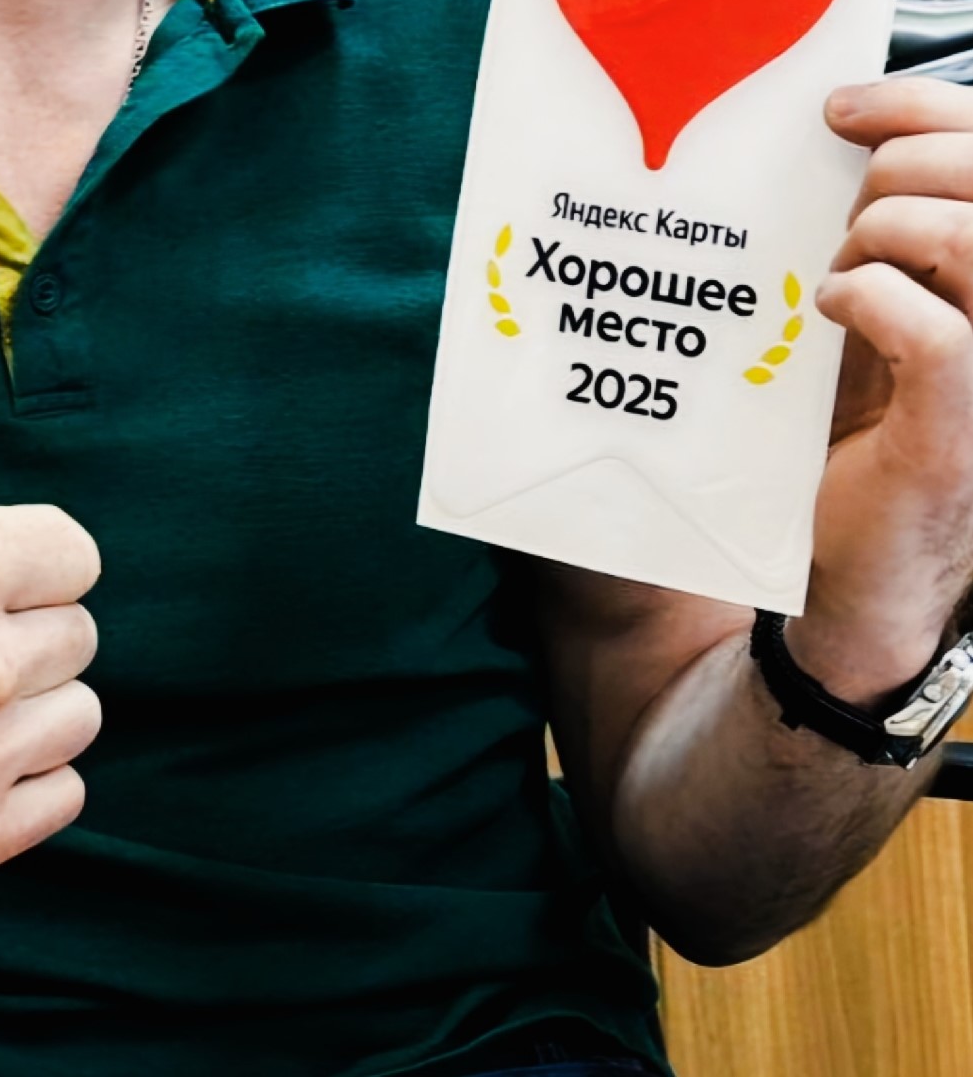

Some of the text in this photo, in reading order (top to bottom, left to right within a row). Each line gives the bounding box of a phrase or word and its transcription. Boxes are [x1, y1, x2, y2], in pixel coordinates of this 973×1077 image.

[551, 192, 748, 250] Яндекс Карты
[525, 237, 758, 317] Хорошее
[558, 302, 707, 358] место
[565, 362, 679, 421] 2025
